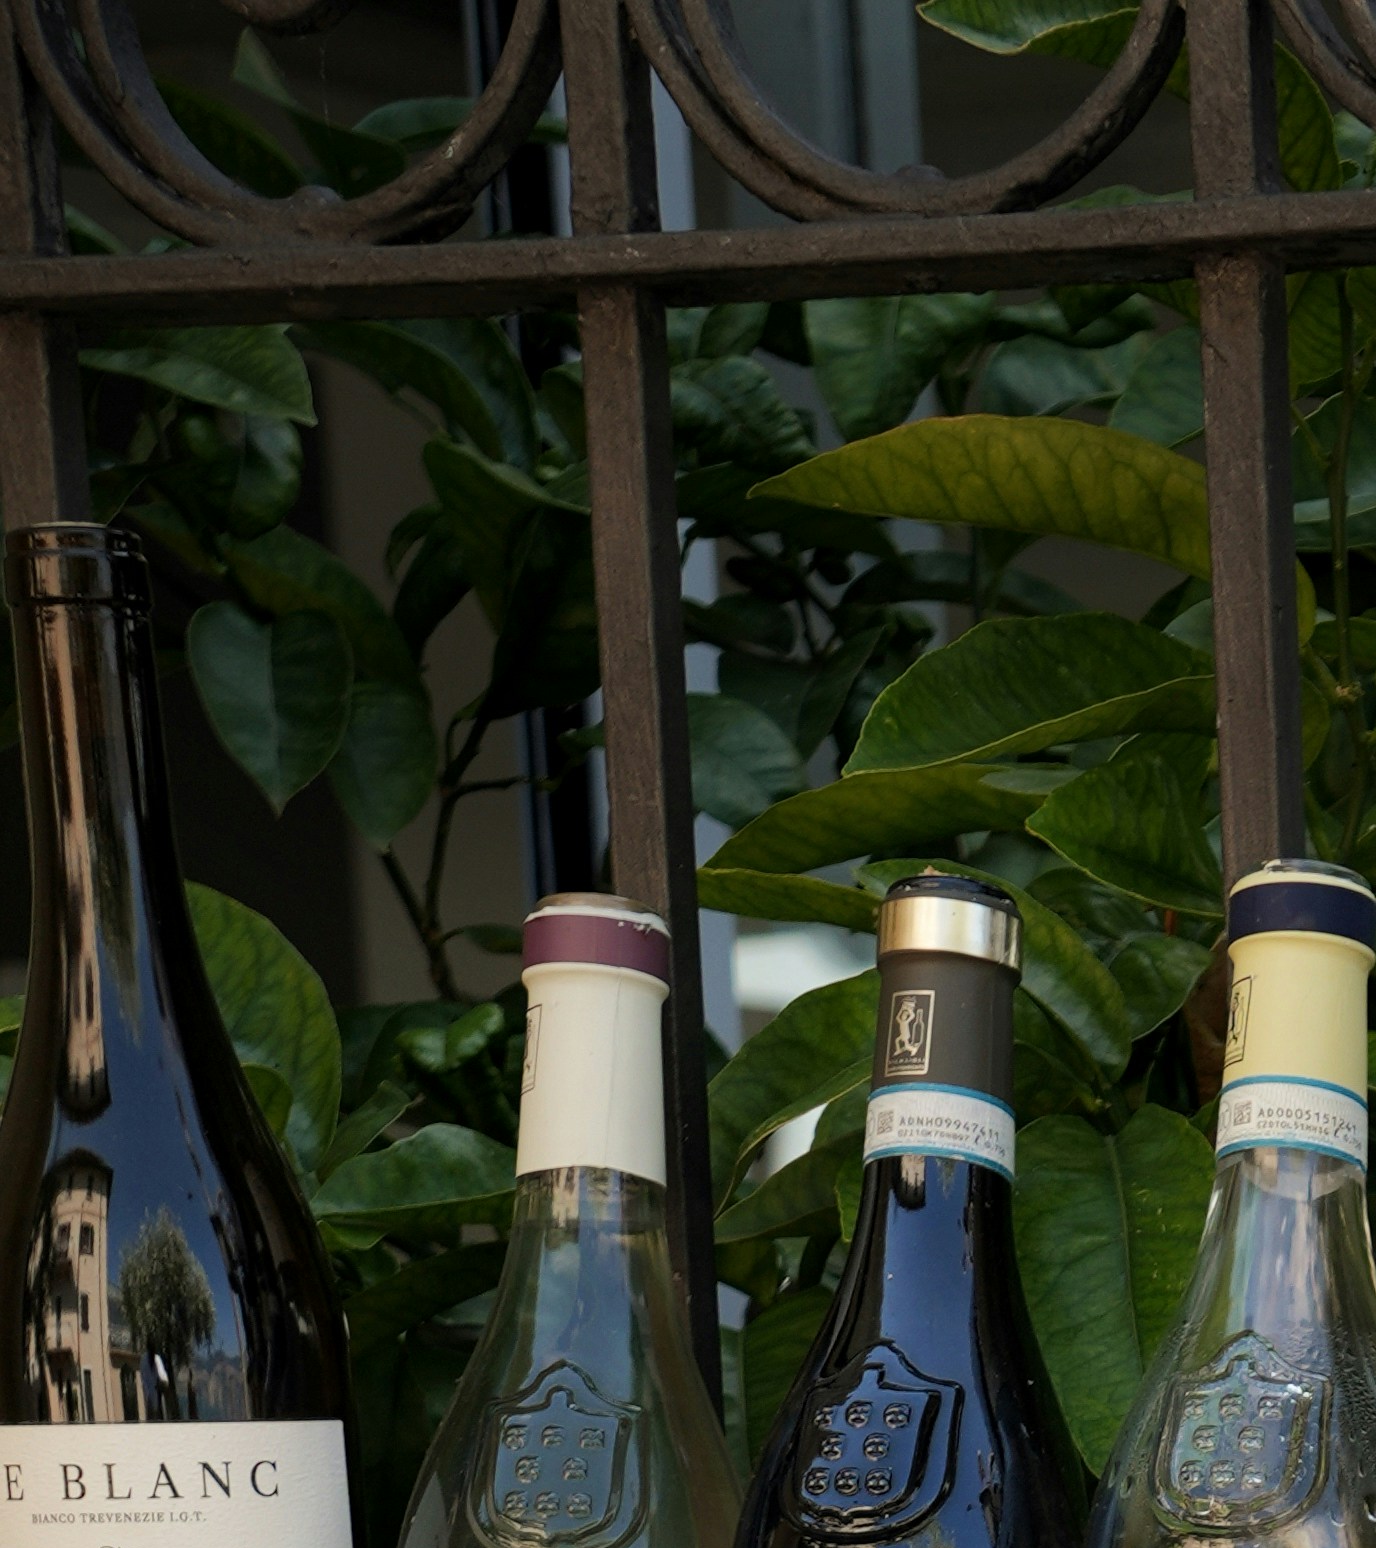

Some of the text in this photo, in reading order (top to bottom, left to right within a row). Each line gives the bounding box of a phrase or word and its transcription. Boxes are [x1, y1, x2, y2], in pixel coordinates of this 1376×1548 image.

[59, 1459, 281, 1501] BLANC
[31, 1510, 165, 1525] BIANCO TREVENEZIE
